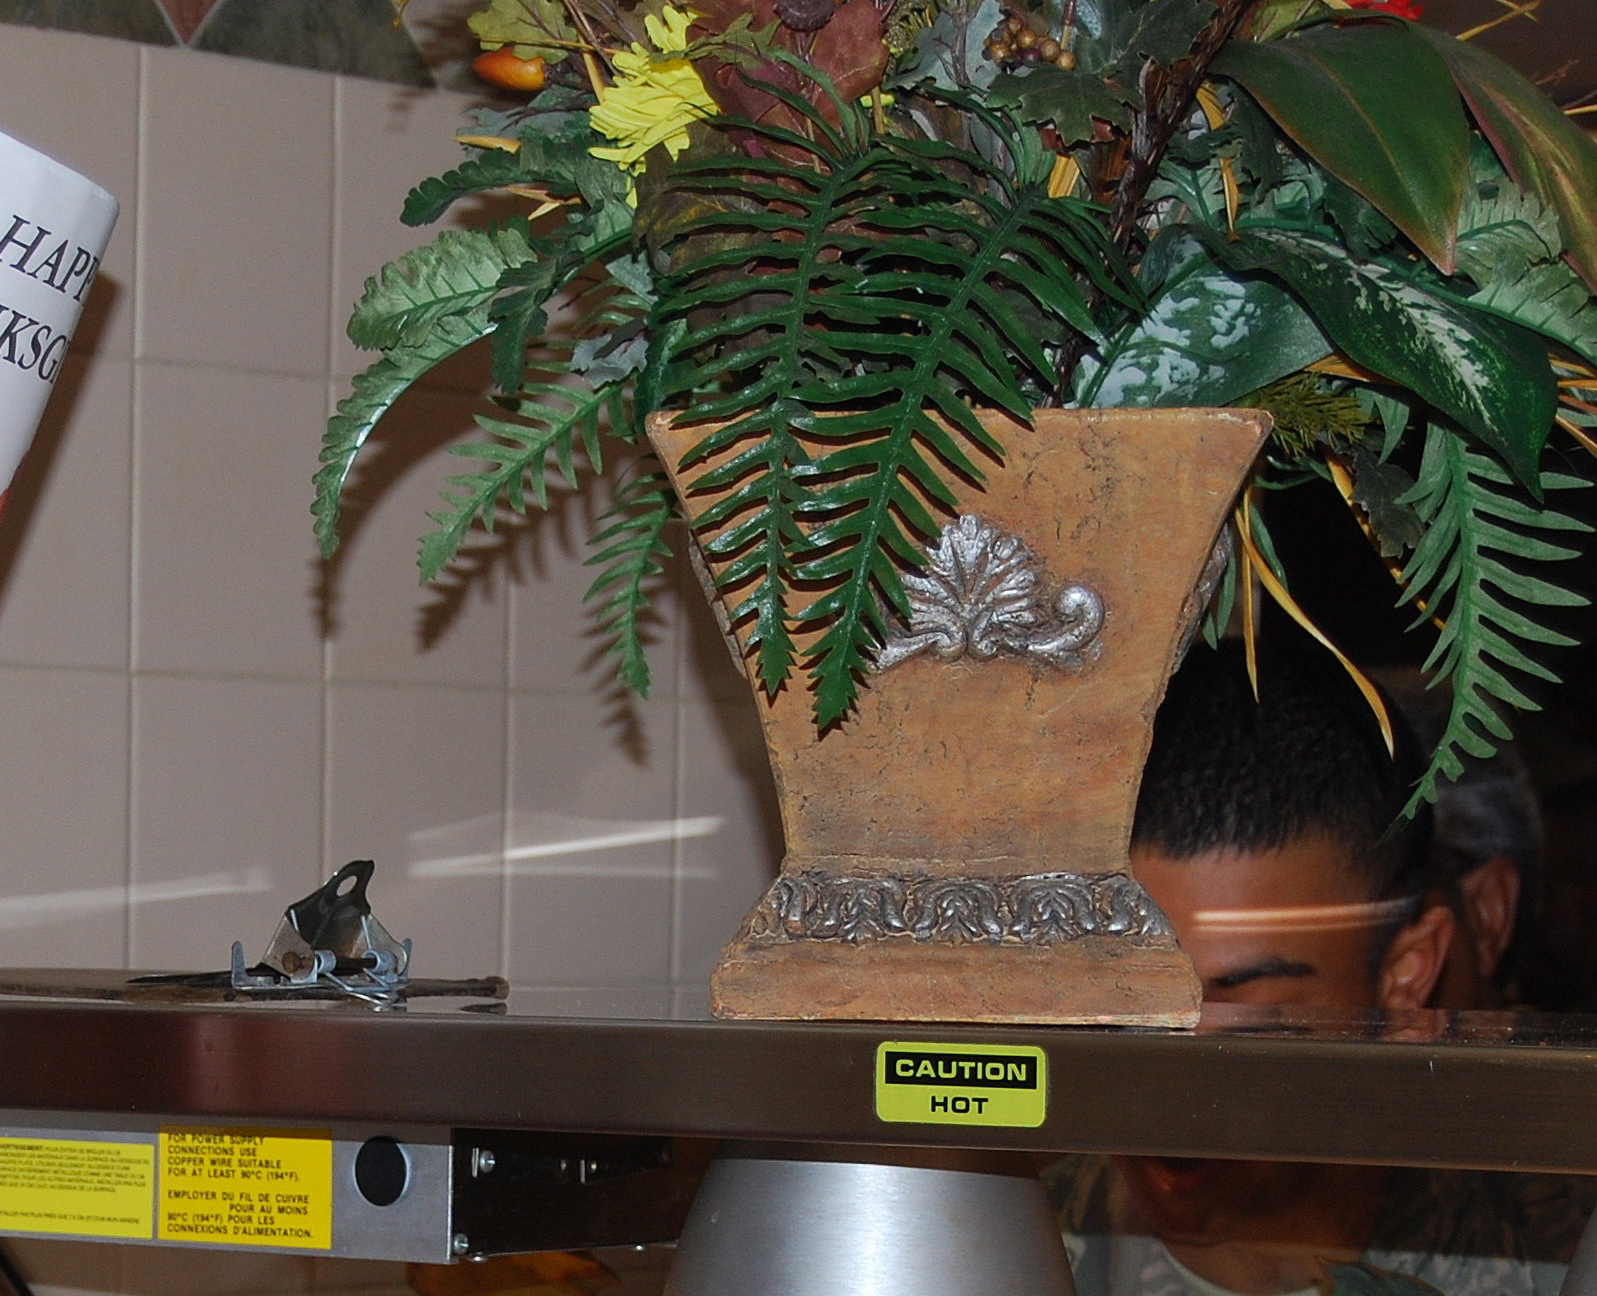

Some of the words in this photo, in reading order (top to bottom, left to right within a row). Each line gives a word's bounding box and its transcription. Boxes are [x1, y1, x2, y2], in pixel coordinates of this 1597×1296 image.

[895, 1058, 1027, 1081] CAUTION
[930, 1095, 989, 1114] HOT
[167, 1133, 186, 1143] FOR
[167, 1145, 235, 1156] CONNECTIONS
[239, 1147, 257, 1157] USE
[167, 1156, 204, 1166] COPPER
[209, 1157, 232, 1168] WIRE
[237, 1159, 282, 1169] SUITABLE
[167, 1167, 186, 1176] FOR
[191, 1168, 203, 1177] AT
[208, 1169, 236, 1178] LEAST
[167, 1189, 217, 1200] EMPLOYER
[222, 1191, 234, 1201] DU
[239, 1192, 252, 1202] FIL
[258, 1193, 270, 1203] DE
[275, 1193, 309, 1204] CUIVRE
[229, 1203, 254, 1213] POUR
[260, 1204, 272, 1214] AU
[277, 1205, 308, 1216] MOINS
[228, 1214, 253, 1224] POUR
[257, 1215, 275, 1225] LES
[167, 1223, 228, 1234] CONNEXIONS
